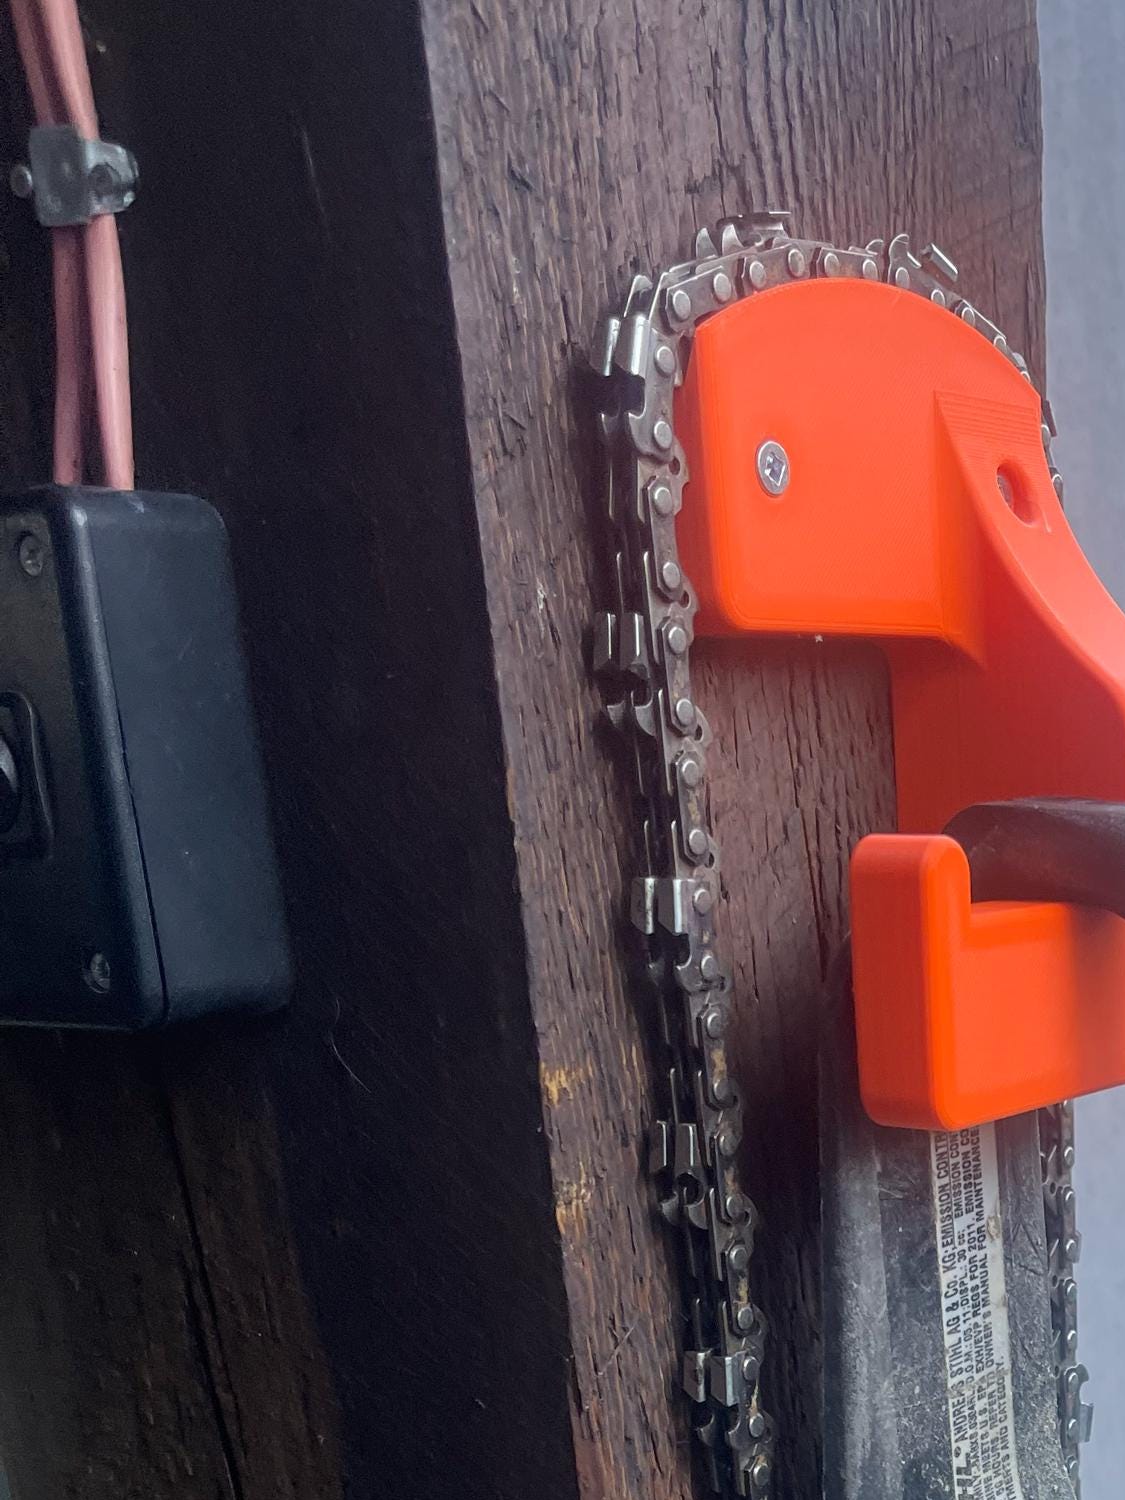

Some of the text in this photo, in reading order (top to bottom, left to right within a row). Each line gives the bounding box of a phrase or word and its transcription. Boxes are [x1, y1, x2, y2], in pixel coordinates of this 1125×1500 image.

[951, 1162, 963, 1218] EMISSION
[962, 1150, 974, 1214] EMISSION
[937, 1183, 954, 1248] EMISSION
[957, 1250, 967, 1263] 30
[976, 1224, 986, 1251] FOR
[968, 1254, 978, 1281] FOR
[980, 1254, 990, 1308] MANUAL
[945, 1300, 959, 1312] &
[970, 1285, 981, 1318] REGS
[946, 1316, 961, 1335] AG
[948, 1337, 963, 1378] STIHL
[996, 1356, 1007, 1423] CATEGOY.
[950, 1380, 968, 1443] ANDREAS
[988, 1390, 998, 1430] REFER
[980, 1432, 991, 1474] MEETS
[999, 1426, 1009, 1449] AND
